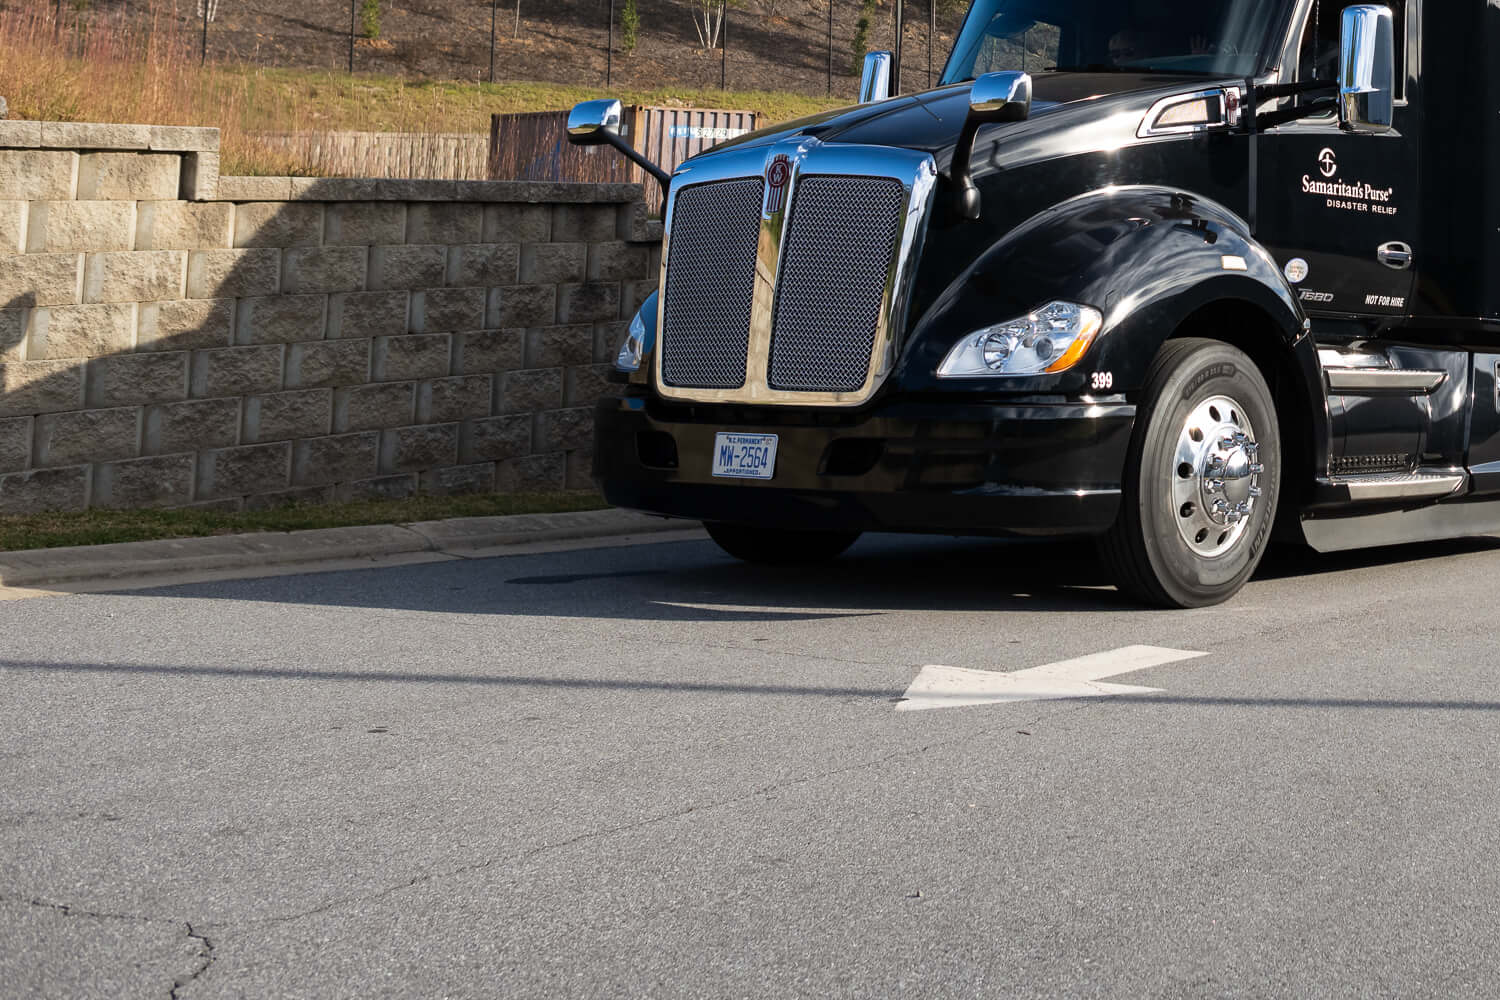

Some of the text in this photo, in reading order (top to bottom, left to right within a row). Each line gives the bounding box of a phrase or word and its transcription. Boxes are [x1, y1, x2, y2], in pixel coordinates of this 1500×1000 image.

[1302, 174, 1364, 199] Samaritan's
[1326, 199, 1398, 215] DISASTER RELIEF
[1365, 294, 1405, 308] NOT FOR HIRE
[1091, 371, 1113, 389] 399
